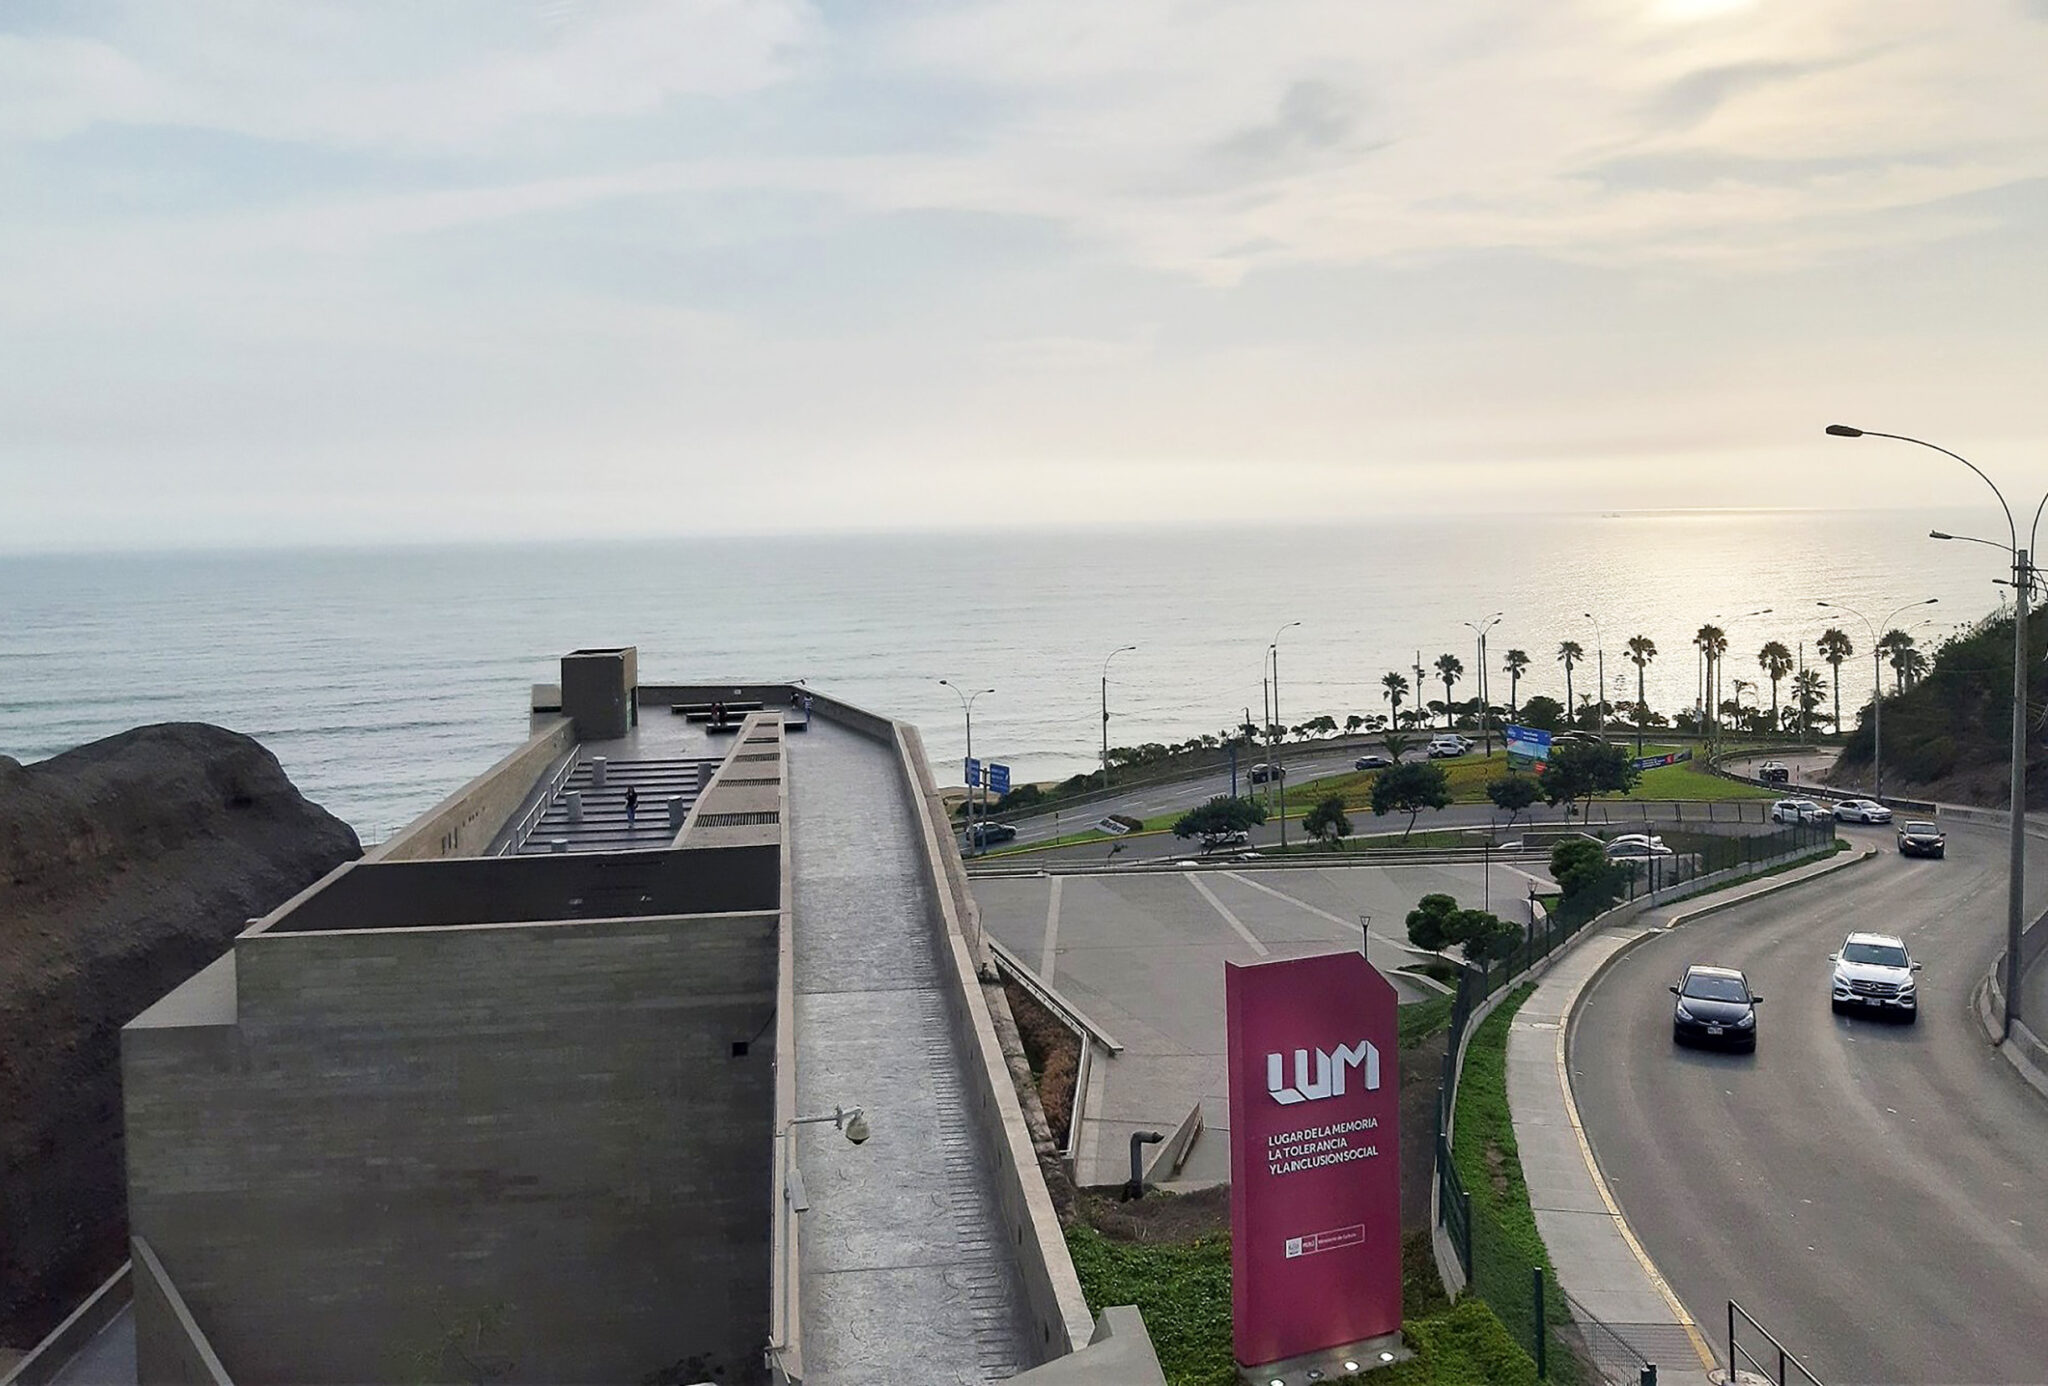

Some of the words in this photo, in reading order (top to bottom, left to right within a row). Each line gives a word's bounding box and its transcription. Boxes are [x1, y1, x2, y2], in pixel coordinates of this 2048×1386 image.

[1267, 1040, 1380, 1105] LUM
[1268, 1131, 1303, 1147] LUGAR
[1304, 1127, 1318, 1140] DE
[1318, 1126, 1332, 1137] LA
[1332, 1117, 1378, 1135] MEMORIA
[1268, 1149, 1283, 1161] LA
[1283, 1138, 1348, 1158] TOLERANCIA
[1269, 1164, 1277, 1175] Y
[1277, 1162, 1291, 1174] LA
[1343, 1145, 1379, 1161] SOCIAL
